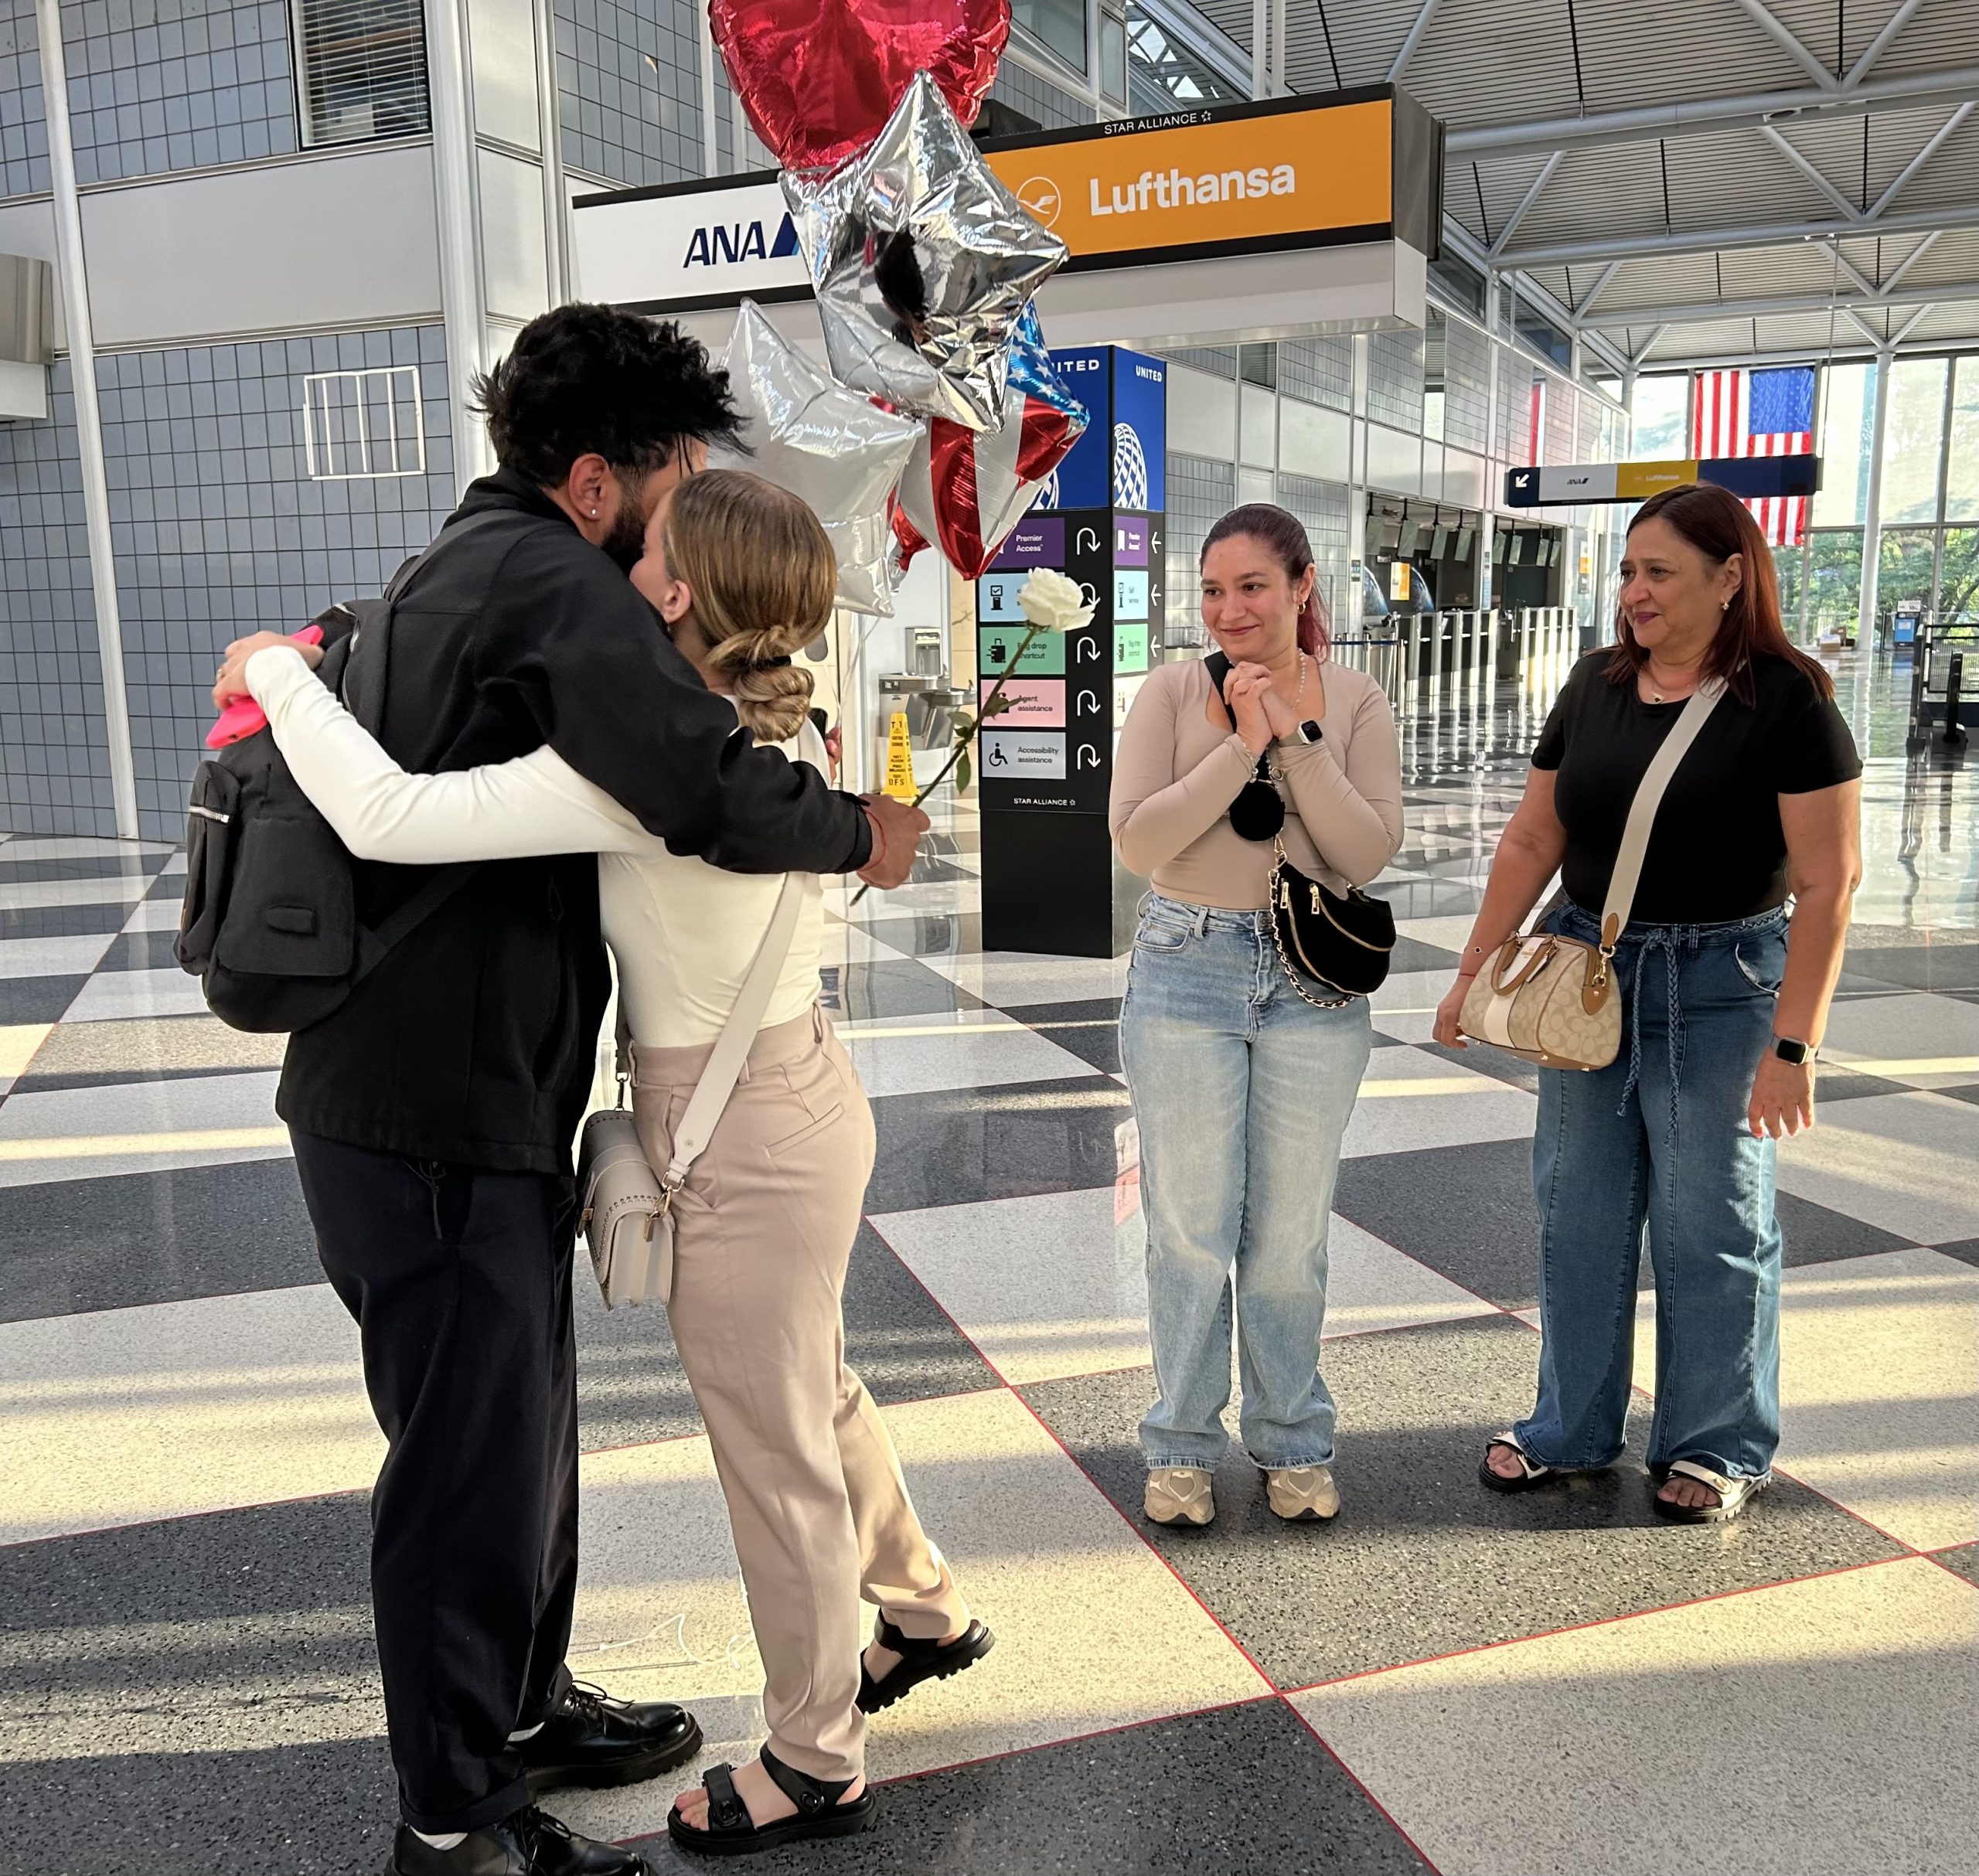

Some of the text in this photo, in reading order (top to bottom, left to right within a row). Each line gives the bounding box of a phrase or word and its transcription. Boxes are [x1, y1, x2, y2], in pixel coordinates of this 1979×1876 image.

[1104, 113, 1197, 134] STAR ALLIANCE
[1090, 164, 1295, 216] Lufthansa
[683, 220, 767, 267] ANA
[1051, 359, 1100, 373] ITED
[1135, 364, 1163, 383] UNITED
[1030, 642, 1047, 651] drop
[1017, 746, 1059, 756] Accessibility
